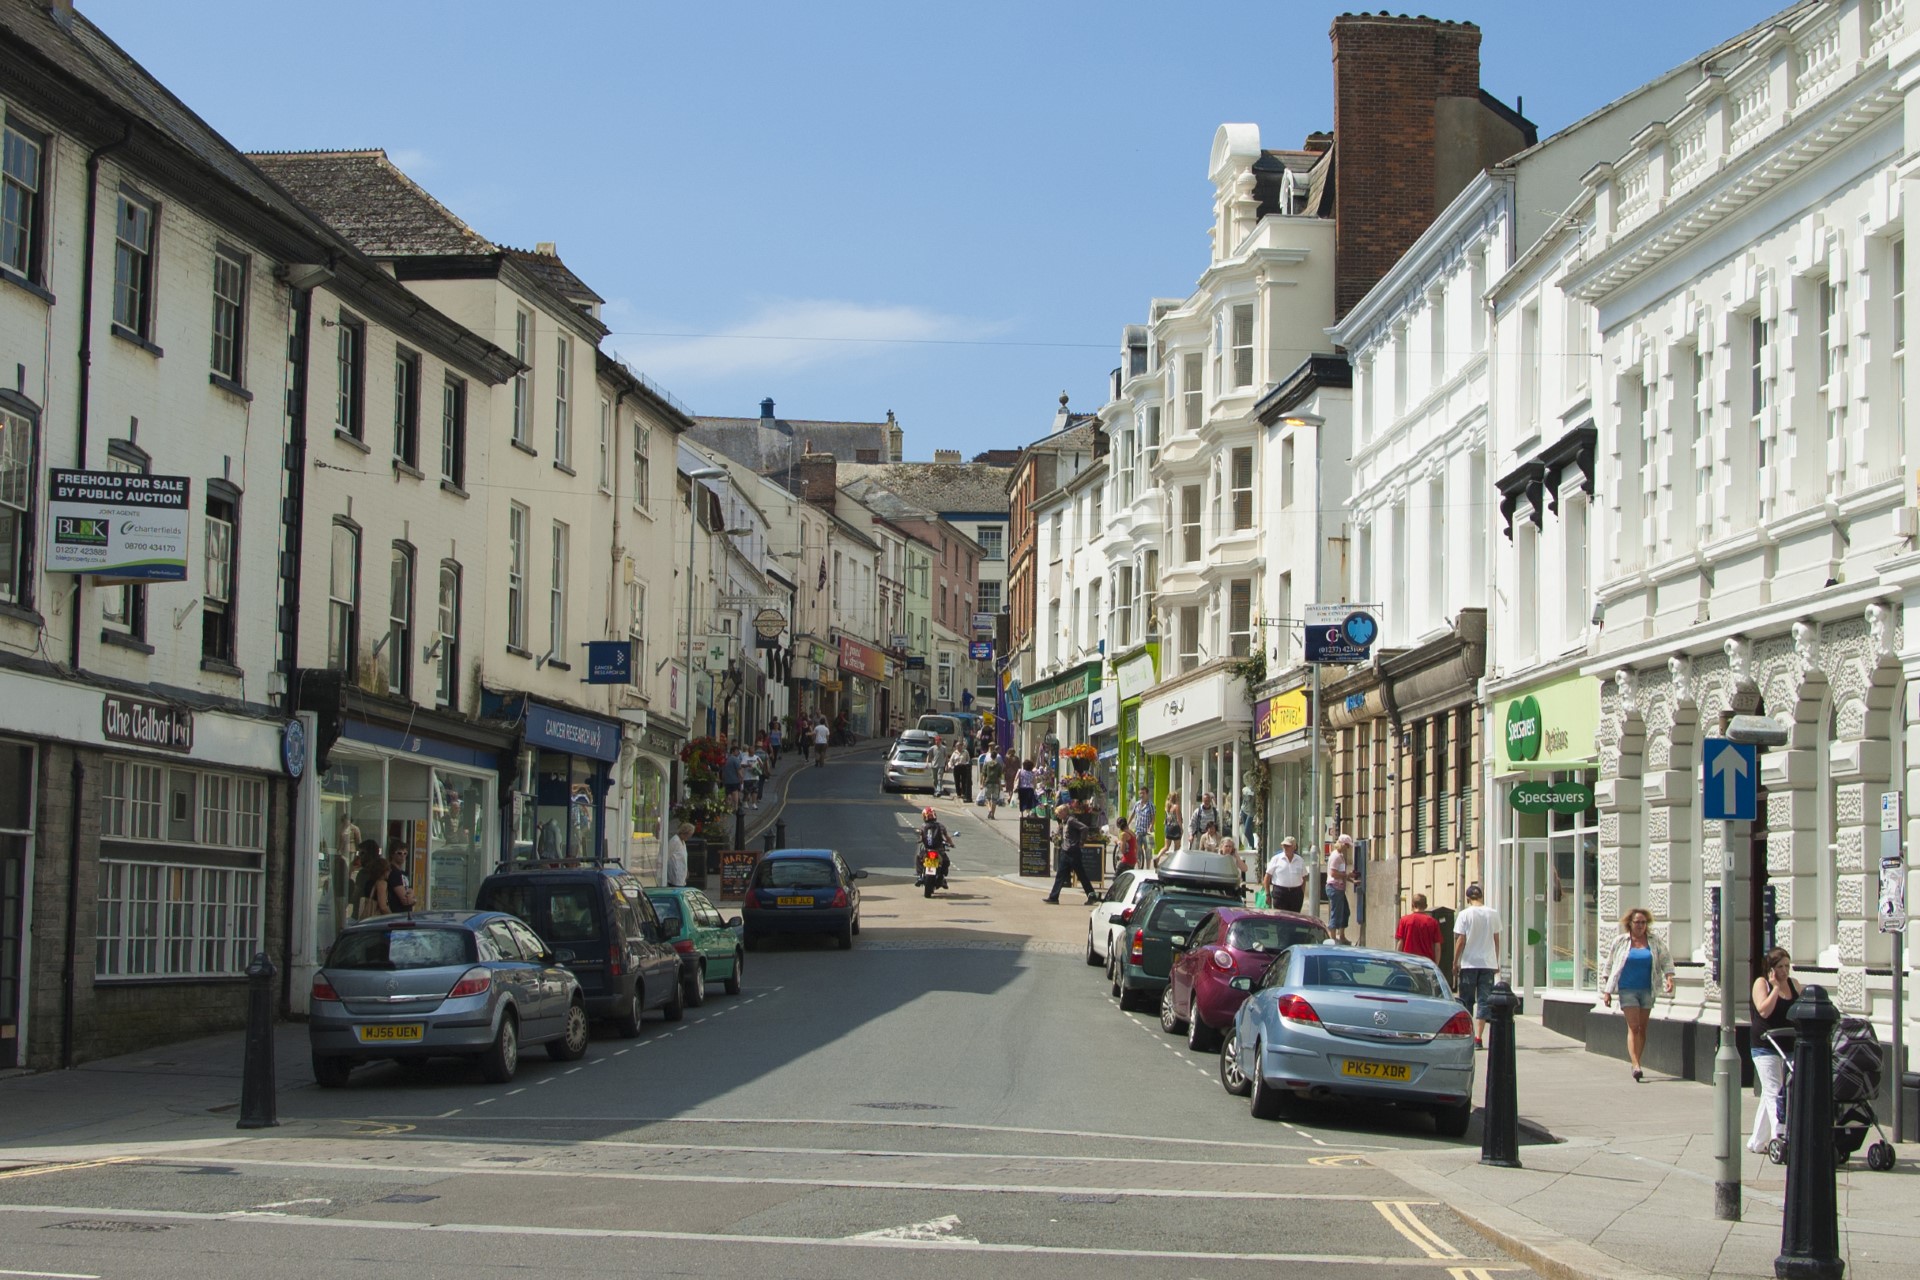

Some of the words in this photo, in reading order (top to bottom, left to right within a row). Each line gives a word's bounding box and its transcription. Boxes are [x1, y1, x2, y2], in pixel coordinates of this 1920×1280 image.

[57, 473, 122, 487] FREEHOLD
[125, 478, 150, 488] FOR
[153, 480, 184, 491] SALE
[58, 487, 75, 497] BY
[78, 488, 124, 500] PUBLIC
[126, 491, 182, 504] AUCTION
[134, 524, 182, 535] charterfields
[55, 546, 78, 554] 01237
[124, 542, 147, 551] 08700
[108, 699, 131, 738] The
[132, 703, 170, 744] Talbot
[545, 719, 566, 740] CANCER
[566, 724, 590, 745] RESEARCH
[1508, 717, 1535, 746] Specsavers
[1518, 791, 1585, 805] Specsavers
[723, 854, 754, 865] HARTS
[365, 1027, 394, 1038] MJ56
[396, 1026, 418, 1038] UEN
[1347, 1061, 1379, 1075] PK57
[1381, 1065, 1406, 1078] XDR
